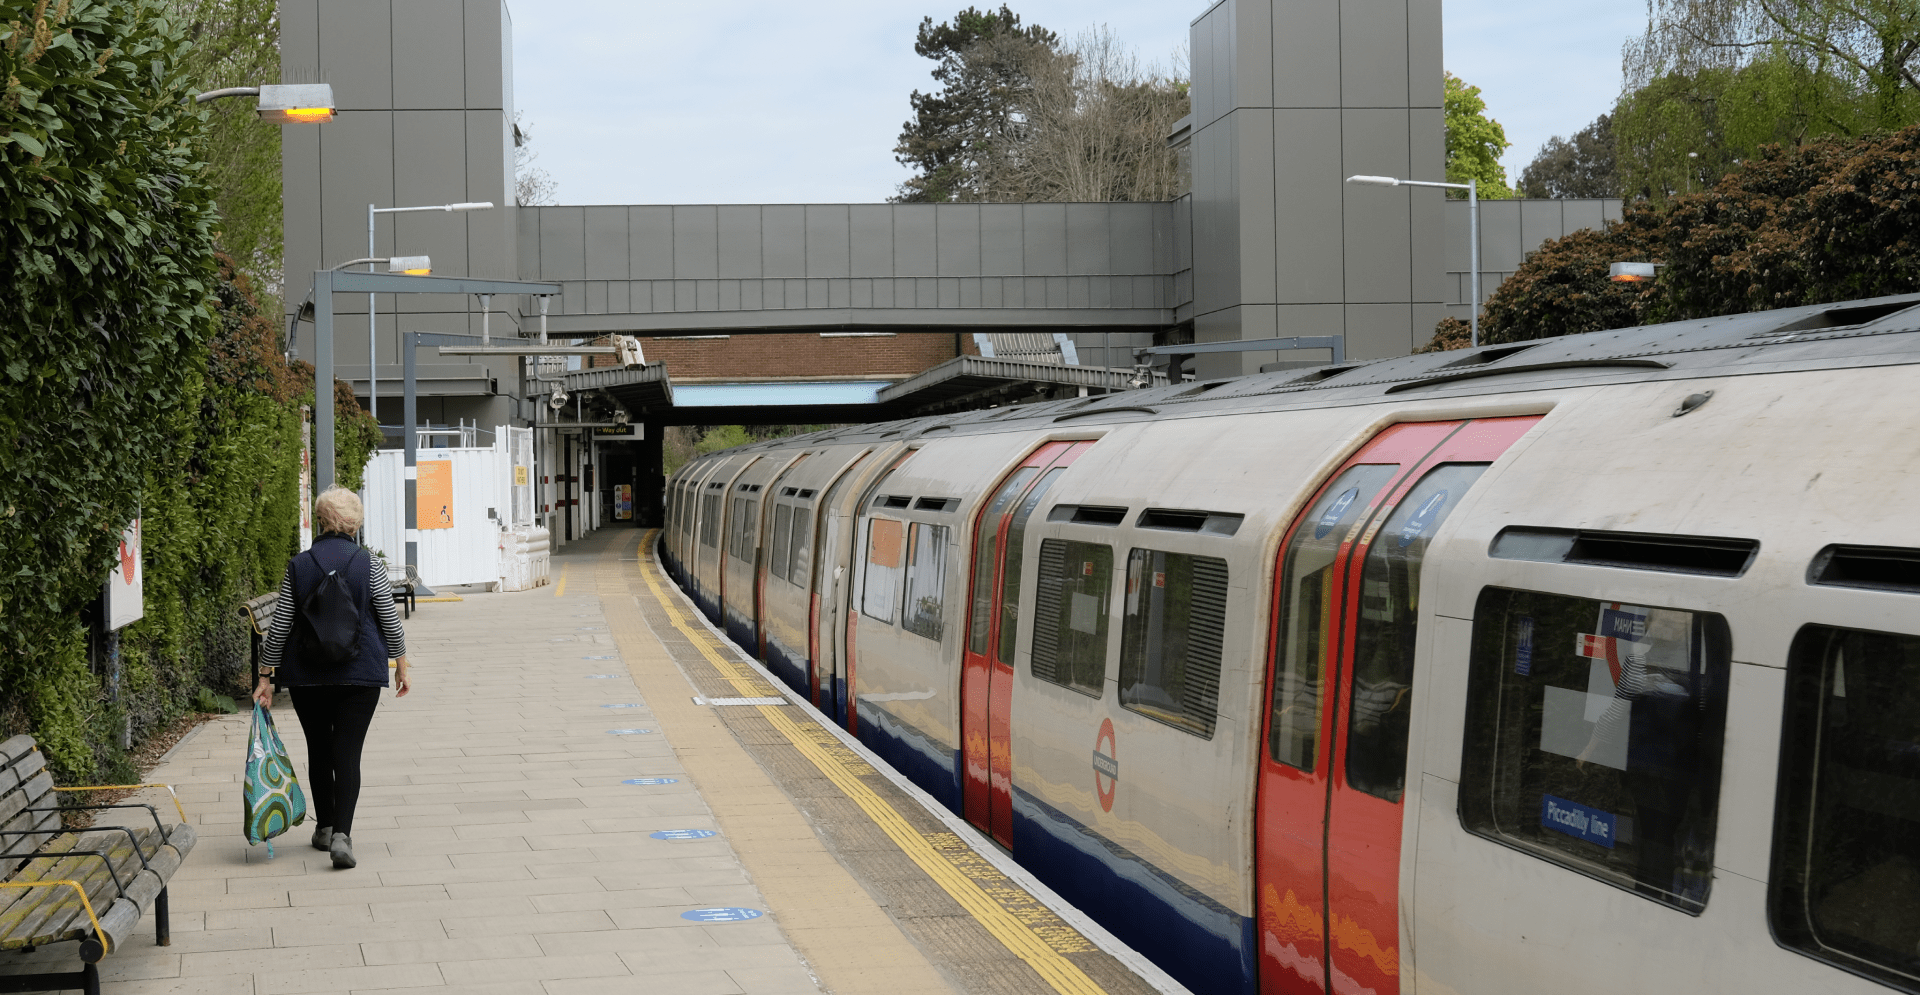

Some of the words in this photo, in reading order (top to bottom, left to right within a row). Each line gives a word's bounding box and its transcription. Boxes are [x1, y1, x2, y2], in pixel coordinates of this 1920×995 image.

[1093, 754, 1117, 775] UNDERGROUND
[1547, 800, 1589, 836] Piccadilly
[1590, 813, 1609, 839] line
